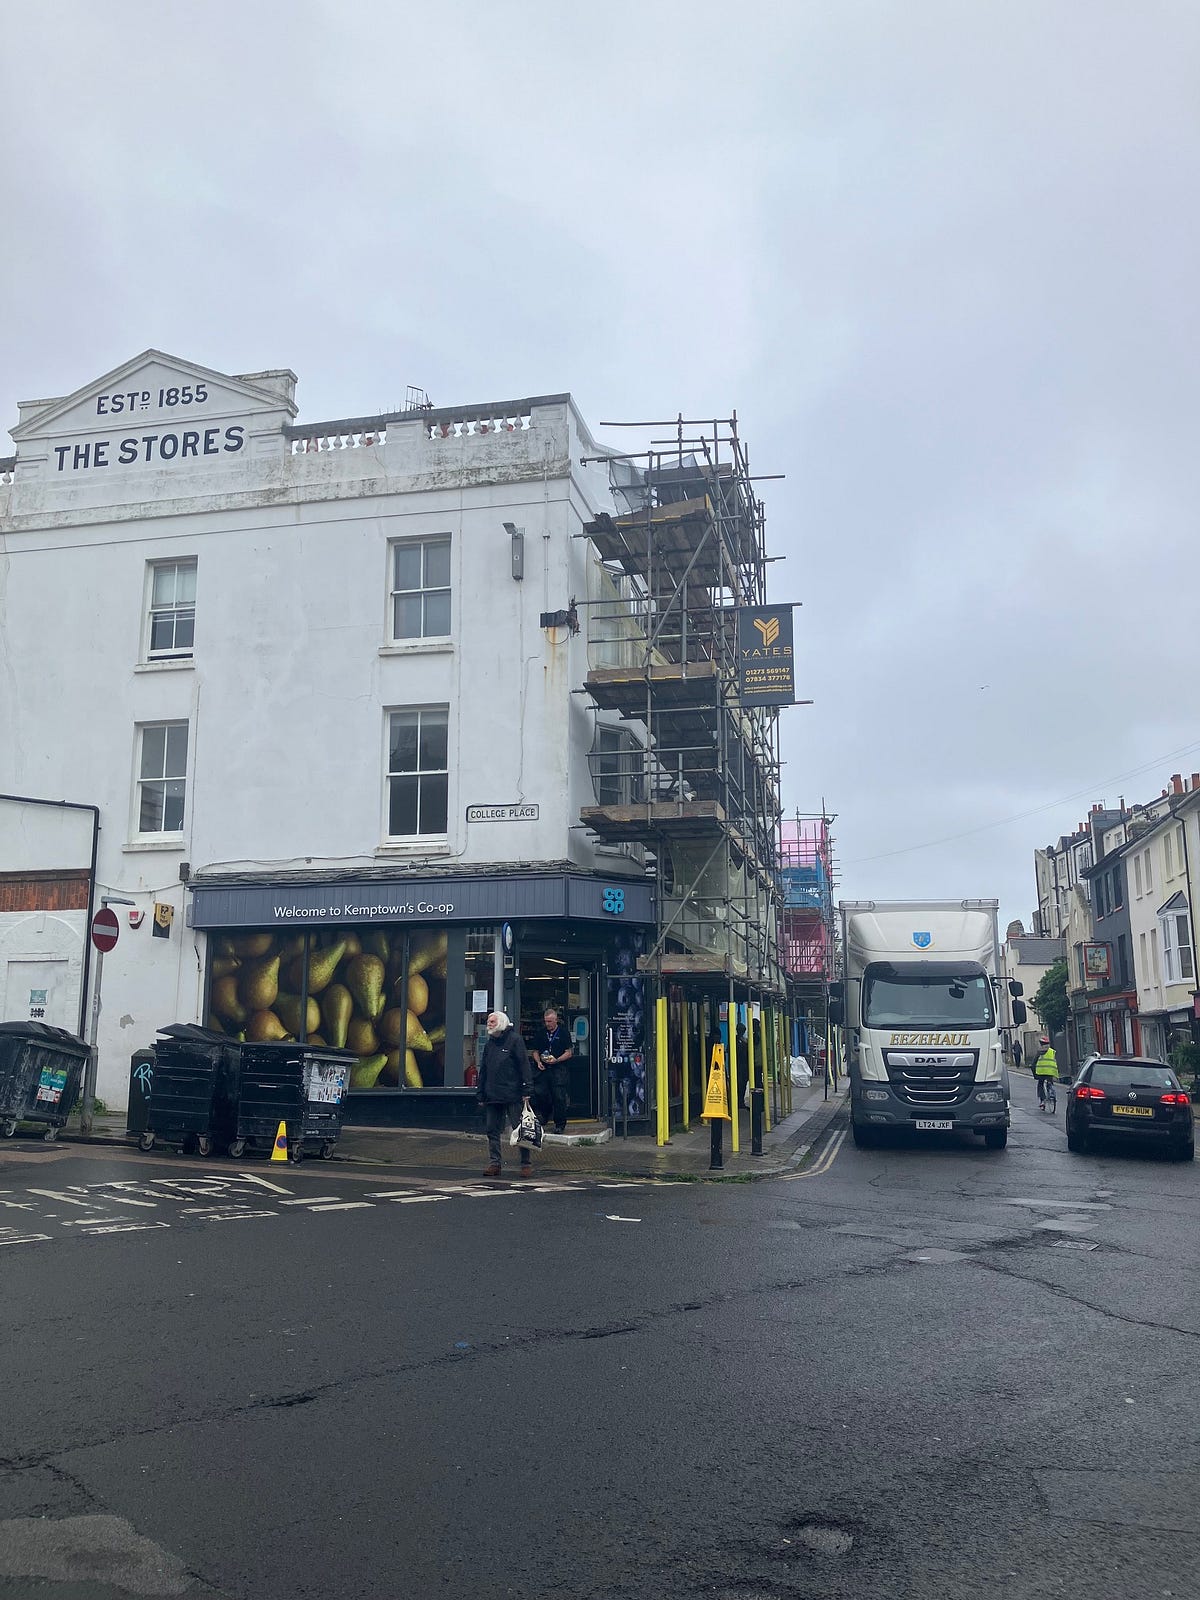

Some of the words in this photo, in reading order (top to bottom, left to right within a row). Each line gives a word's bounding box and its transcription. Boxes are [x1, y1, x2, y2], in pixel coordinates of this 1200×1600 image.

[158, 384, 208, 408] 1855
[54, 441, 110, 471] THE
[118, 426, 245, 464] STORES
[742, 646, 792, 656] YATES
[745, 668, 765, 676] 01273
[470, 809, 505, 819] COLLEGE
[509, 808, 535, 817] PLACE
[274, 905, 326, 917] Welcome
[329, 906, 341, 916] to
[417, 902, 454, 915] Co-op
[889, 1033, 971, 1046] EEZEHAUL
